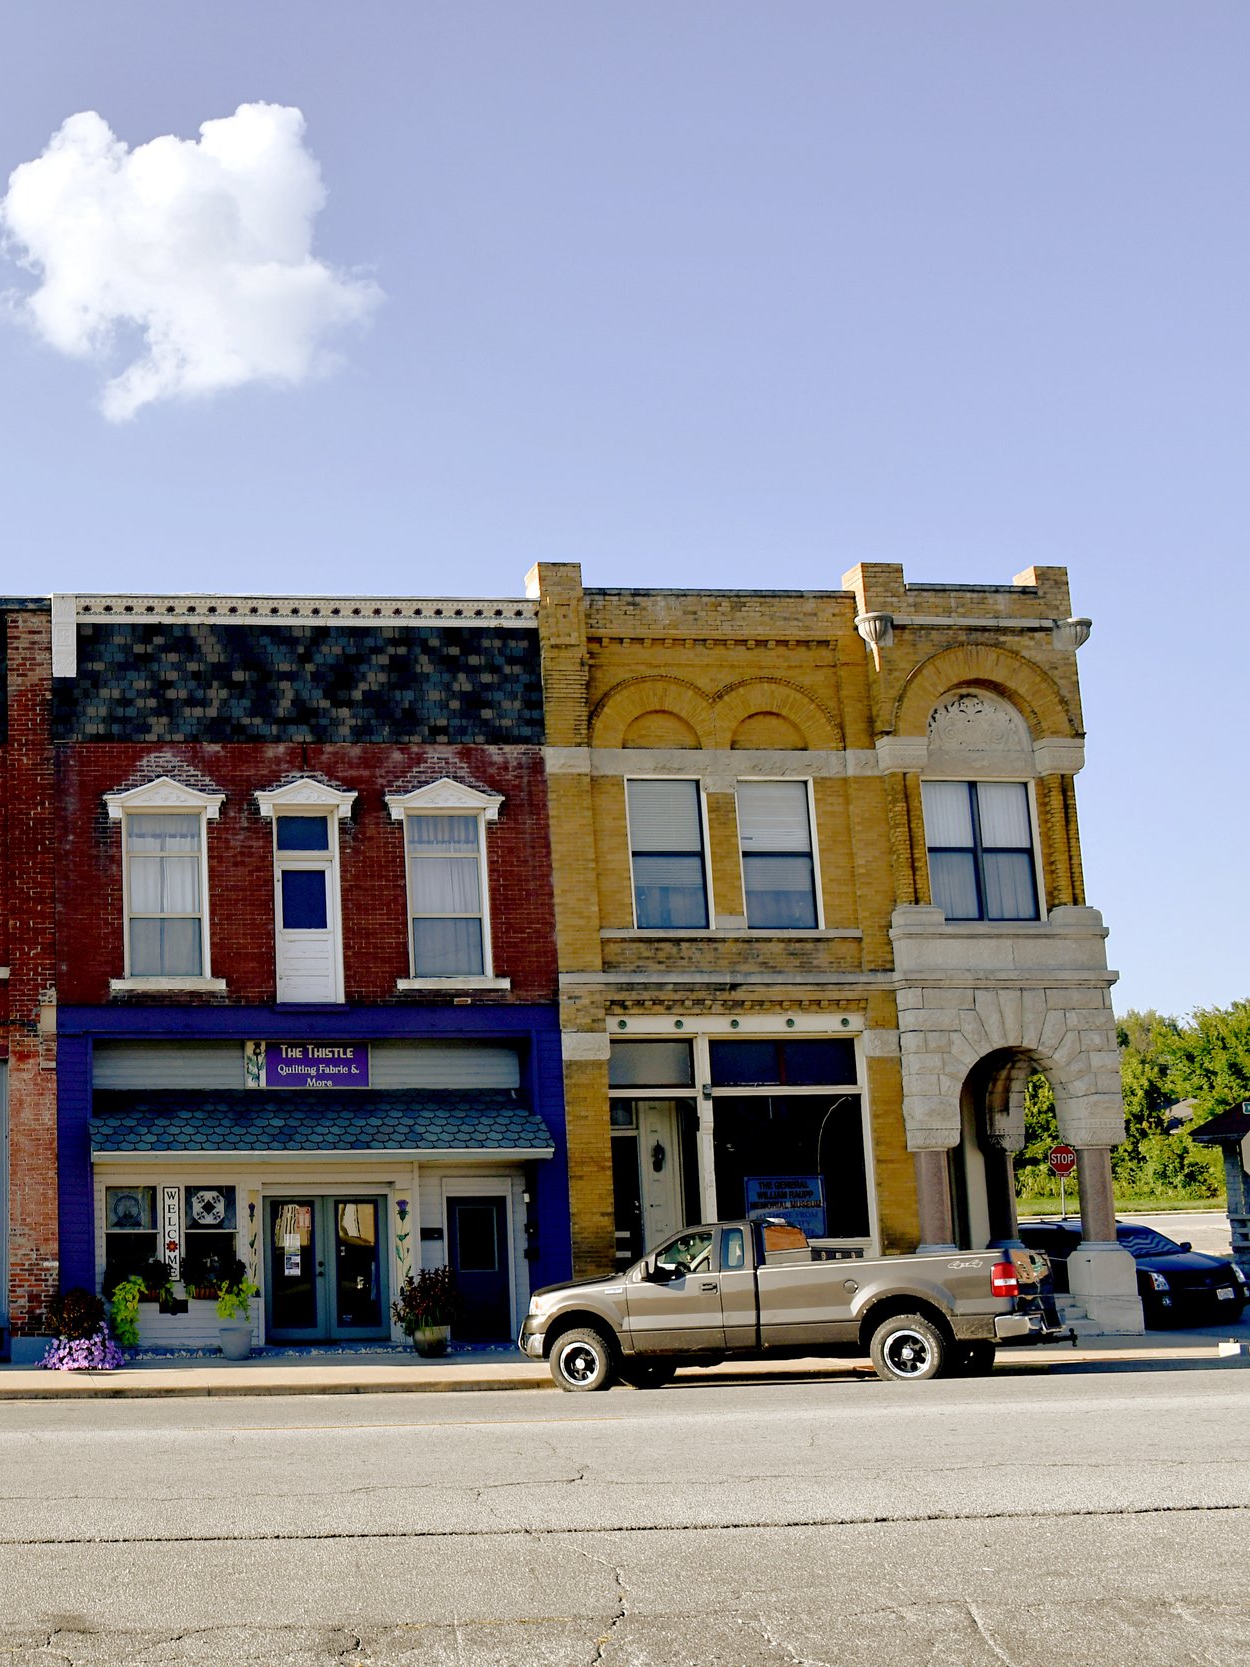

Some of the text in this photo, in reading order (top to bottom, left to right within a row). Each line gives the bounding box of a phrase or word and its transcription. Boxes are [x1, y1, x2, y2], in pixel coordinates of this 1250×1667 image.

[277, 1064, 360, 1076] Quilting Fabric &
[306, 1078, 333, 1088] More
[1051, 1153, 1074, 1164] STOP
[758, 1181, 809, 1189] THE GENERAL
[757, 1191, 787, 1200] WILLIAM
[750, 1200, 822, 1209] MEMORIAL MUSEUM
[165, 1191, 178, 1279] WELCME
